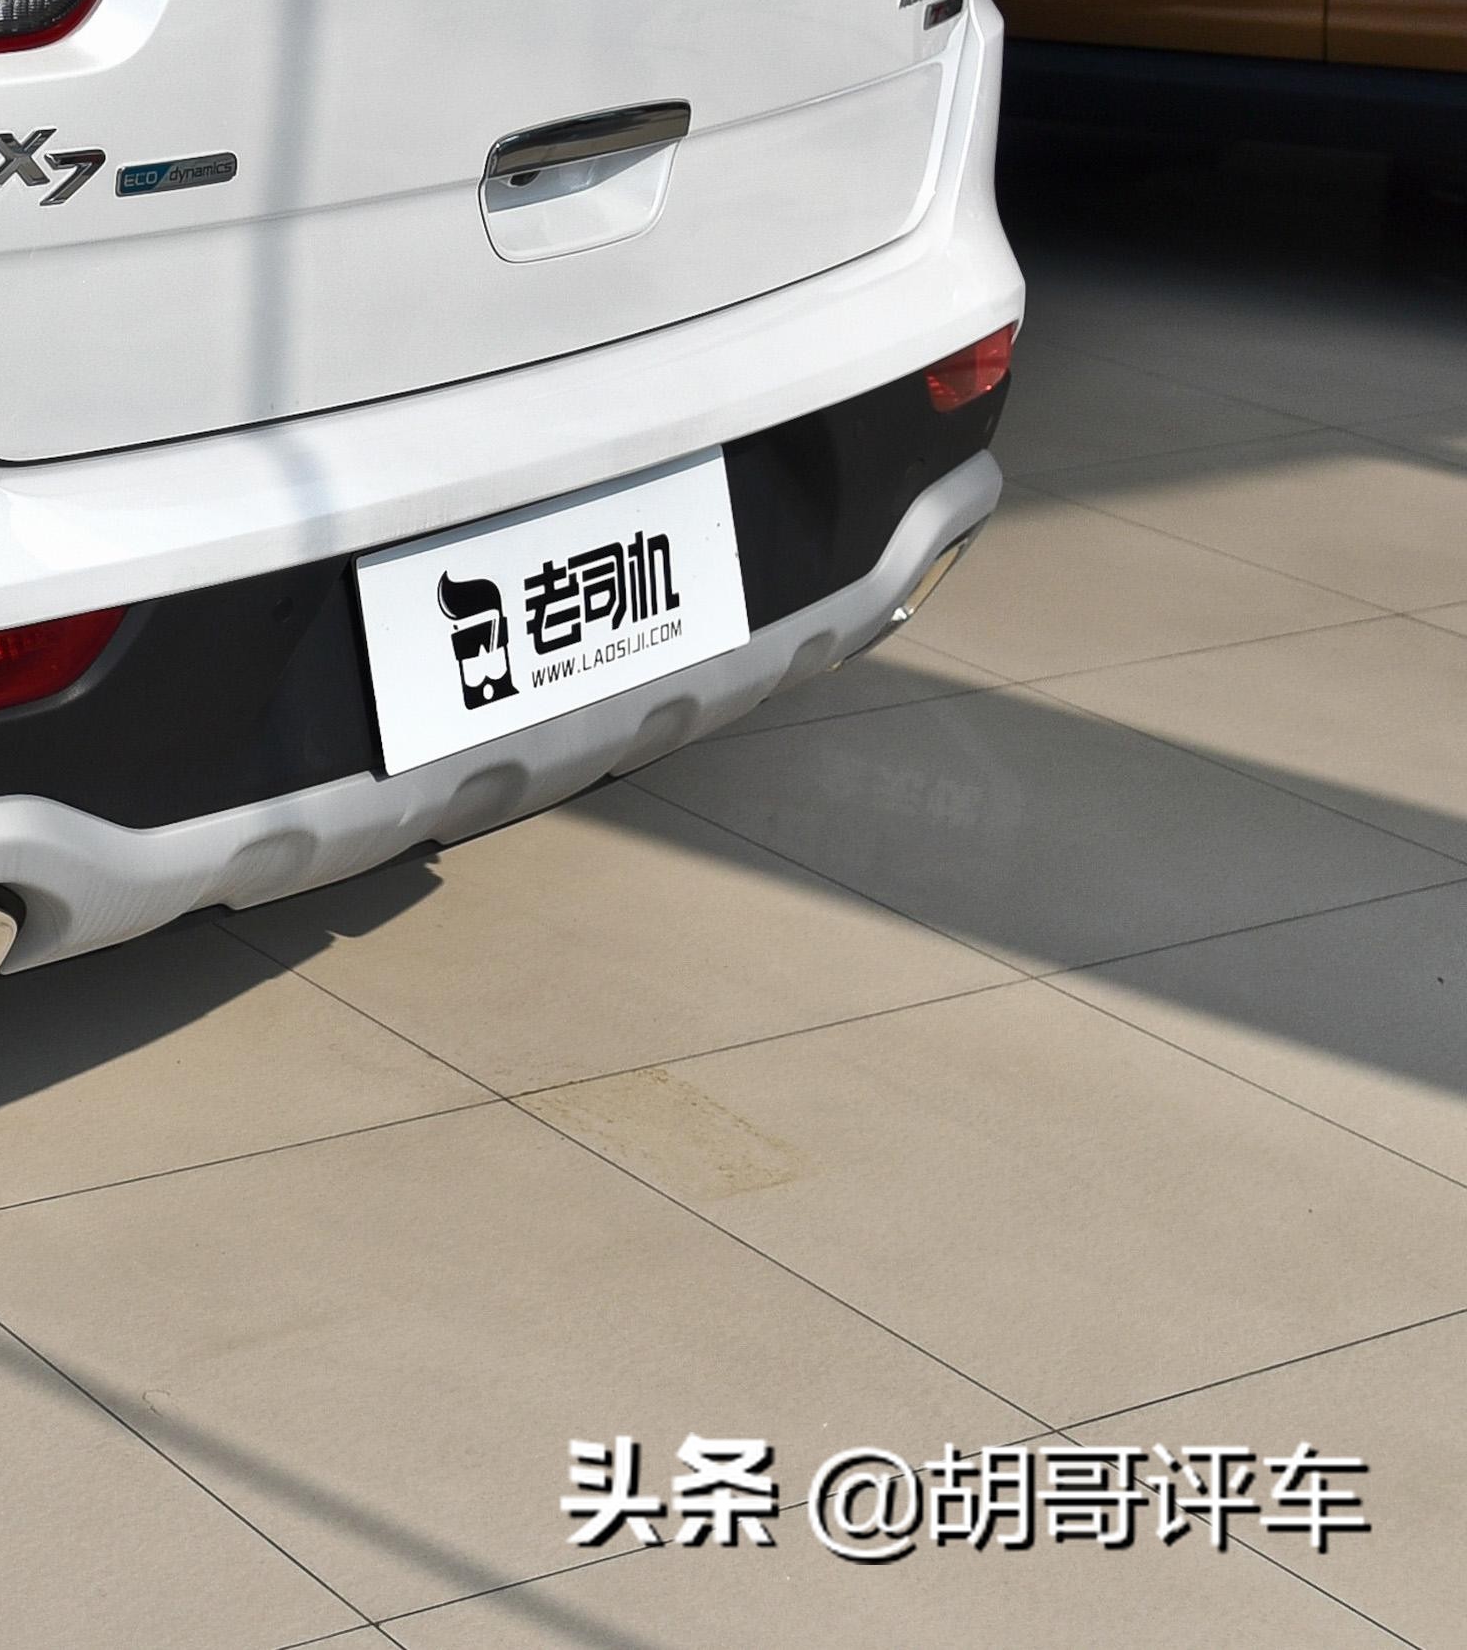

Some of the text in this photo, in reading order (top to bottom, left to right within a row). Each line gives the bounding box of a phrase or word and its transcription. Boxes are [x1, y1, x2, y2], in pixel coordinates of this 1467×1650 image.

[122, 158, 233, 188] ECO dynamics
[523, 530, 681, 656] 老司机
[531, 618, 682, 688] WWW.LAOSIJI.COM
